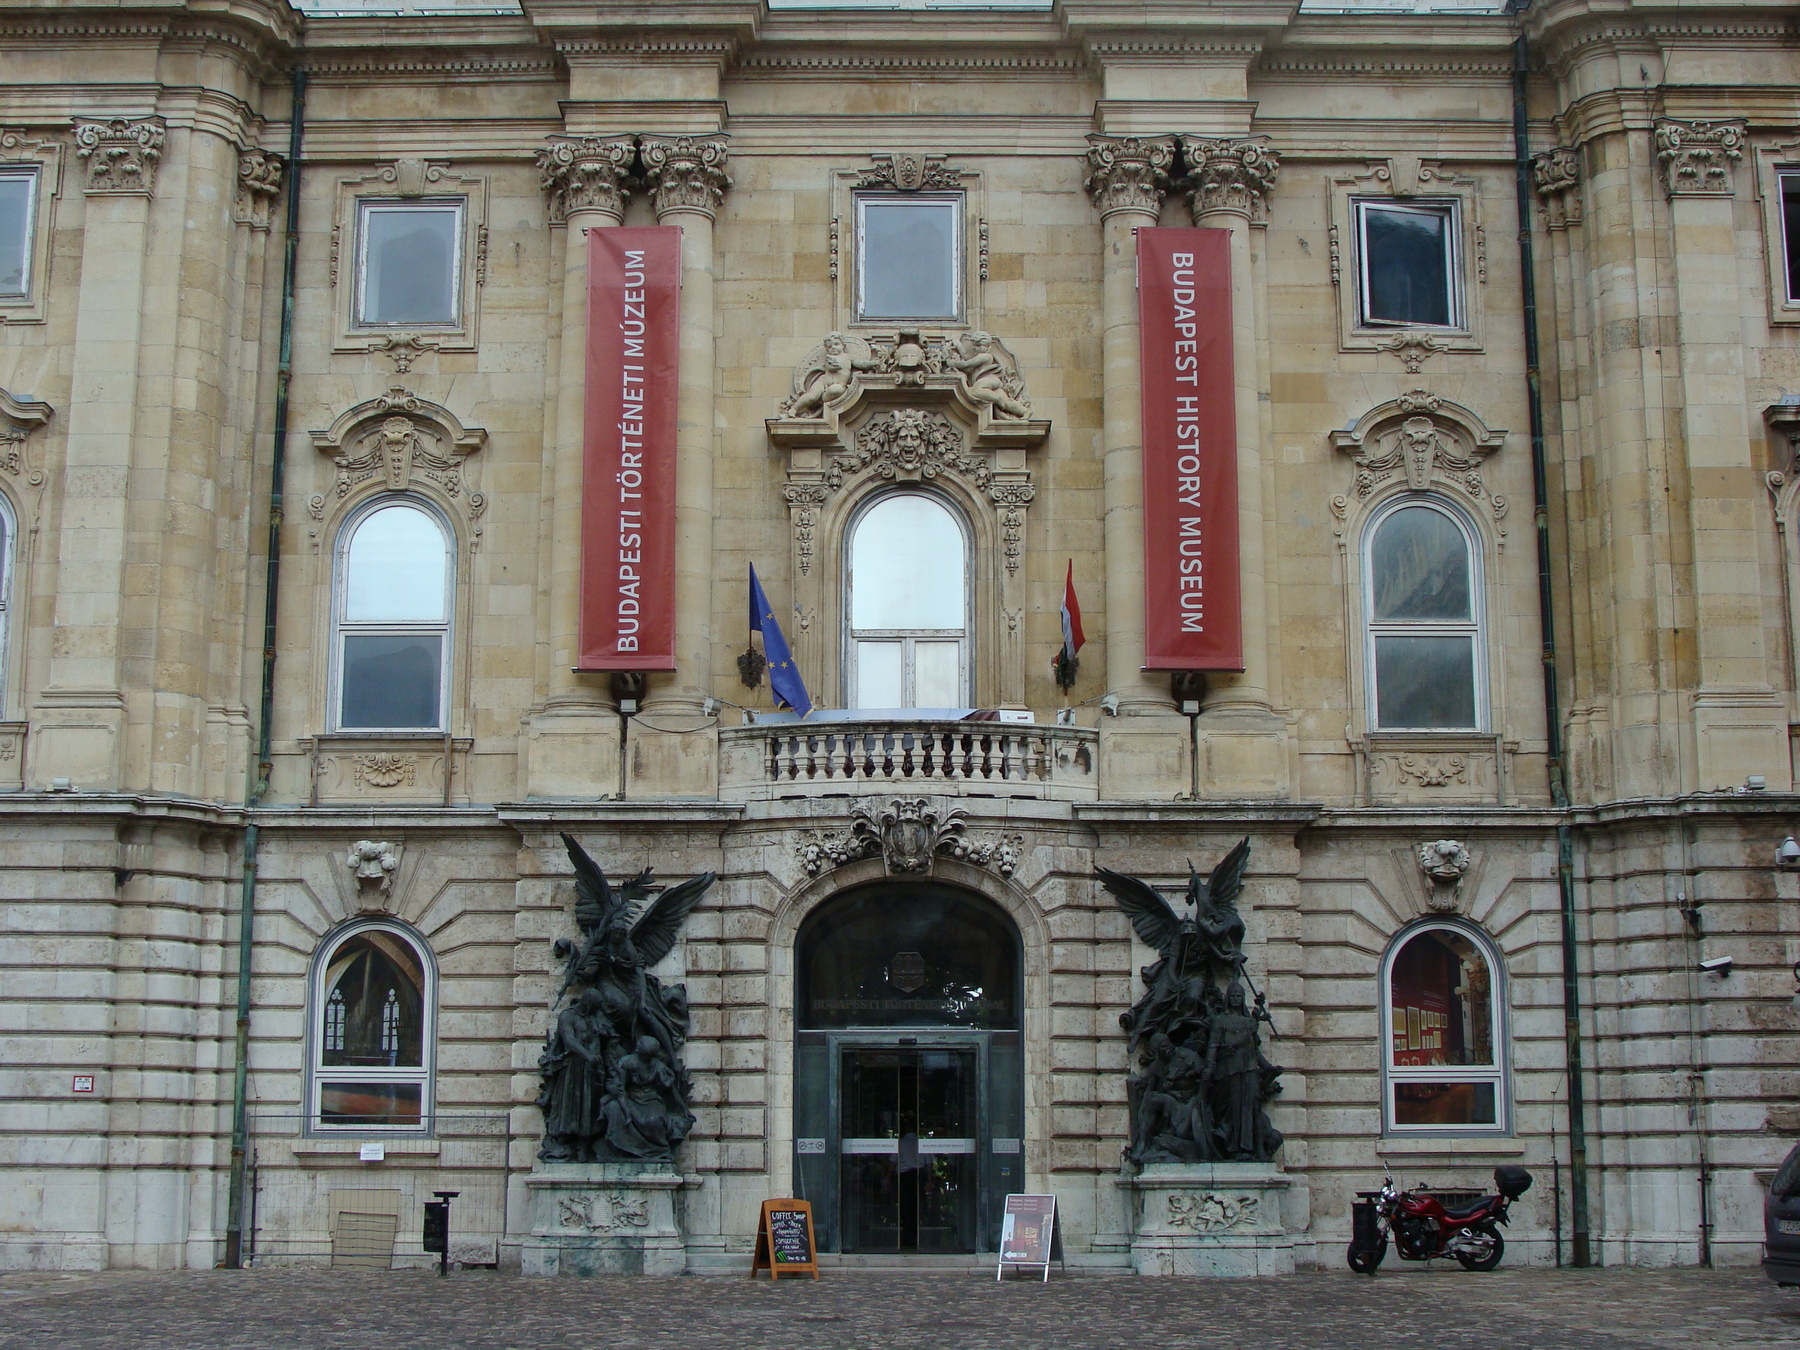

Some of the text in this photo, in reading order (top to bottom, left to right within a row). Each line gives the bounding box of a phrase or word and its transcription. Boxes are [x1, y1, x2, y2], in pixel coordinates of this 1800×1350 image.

[616, 250, 646, 652] BUDAPESTI TÖRTÉNETI MÚZEUM
[1172, 252, 1204, 632] BUDAPEST HISTORY MUSEUM
